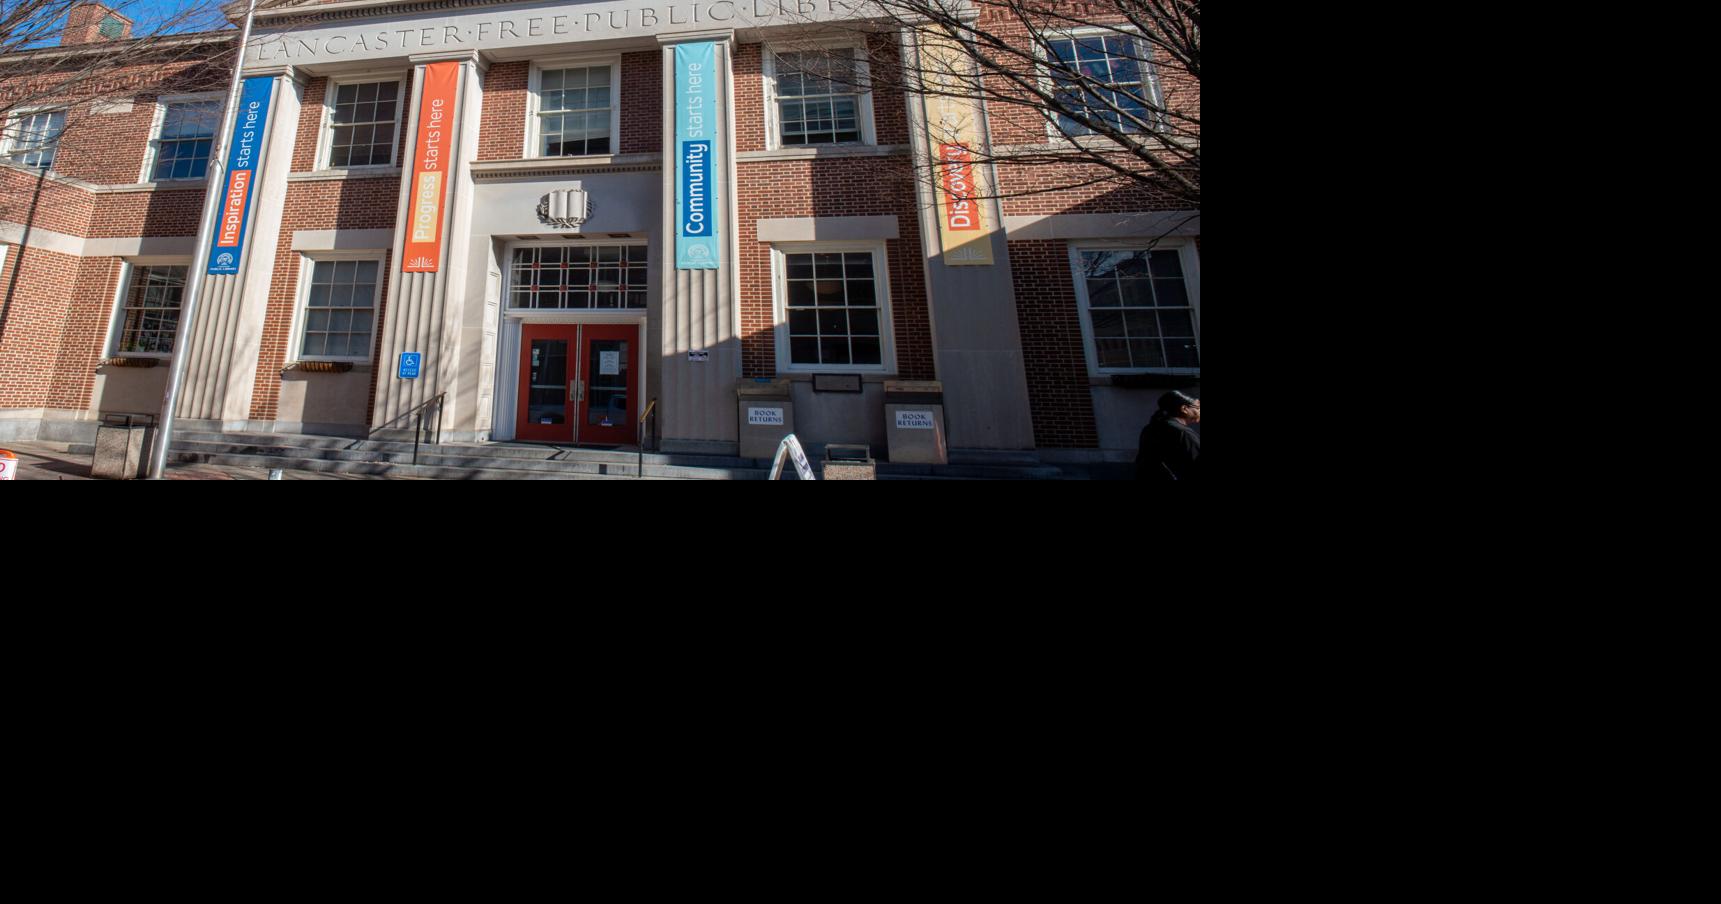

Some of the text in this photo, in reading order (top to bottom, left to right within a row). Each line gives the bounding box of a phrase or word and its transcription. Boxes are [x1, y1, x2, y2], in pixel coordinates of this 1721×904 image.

[258, 0, 854, 61] LANCASTER FREE PUBLIC LIBR
[245, 101, 260, 130] here
[685, 63, 708, 234] Community starts here
[237, 132, 254, 168] starts
[414, 99, 444, 241] Progress starts here
[220, 172, 247, 245] Inspiration
